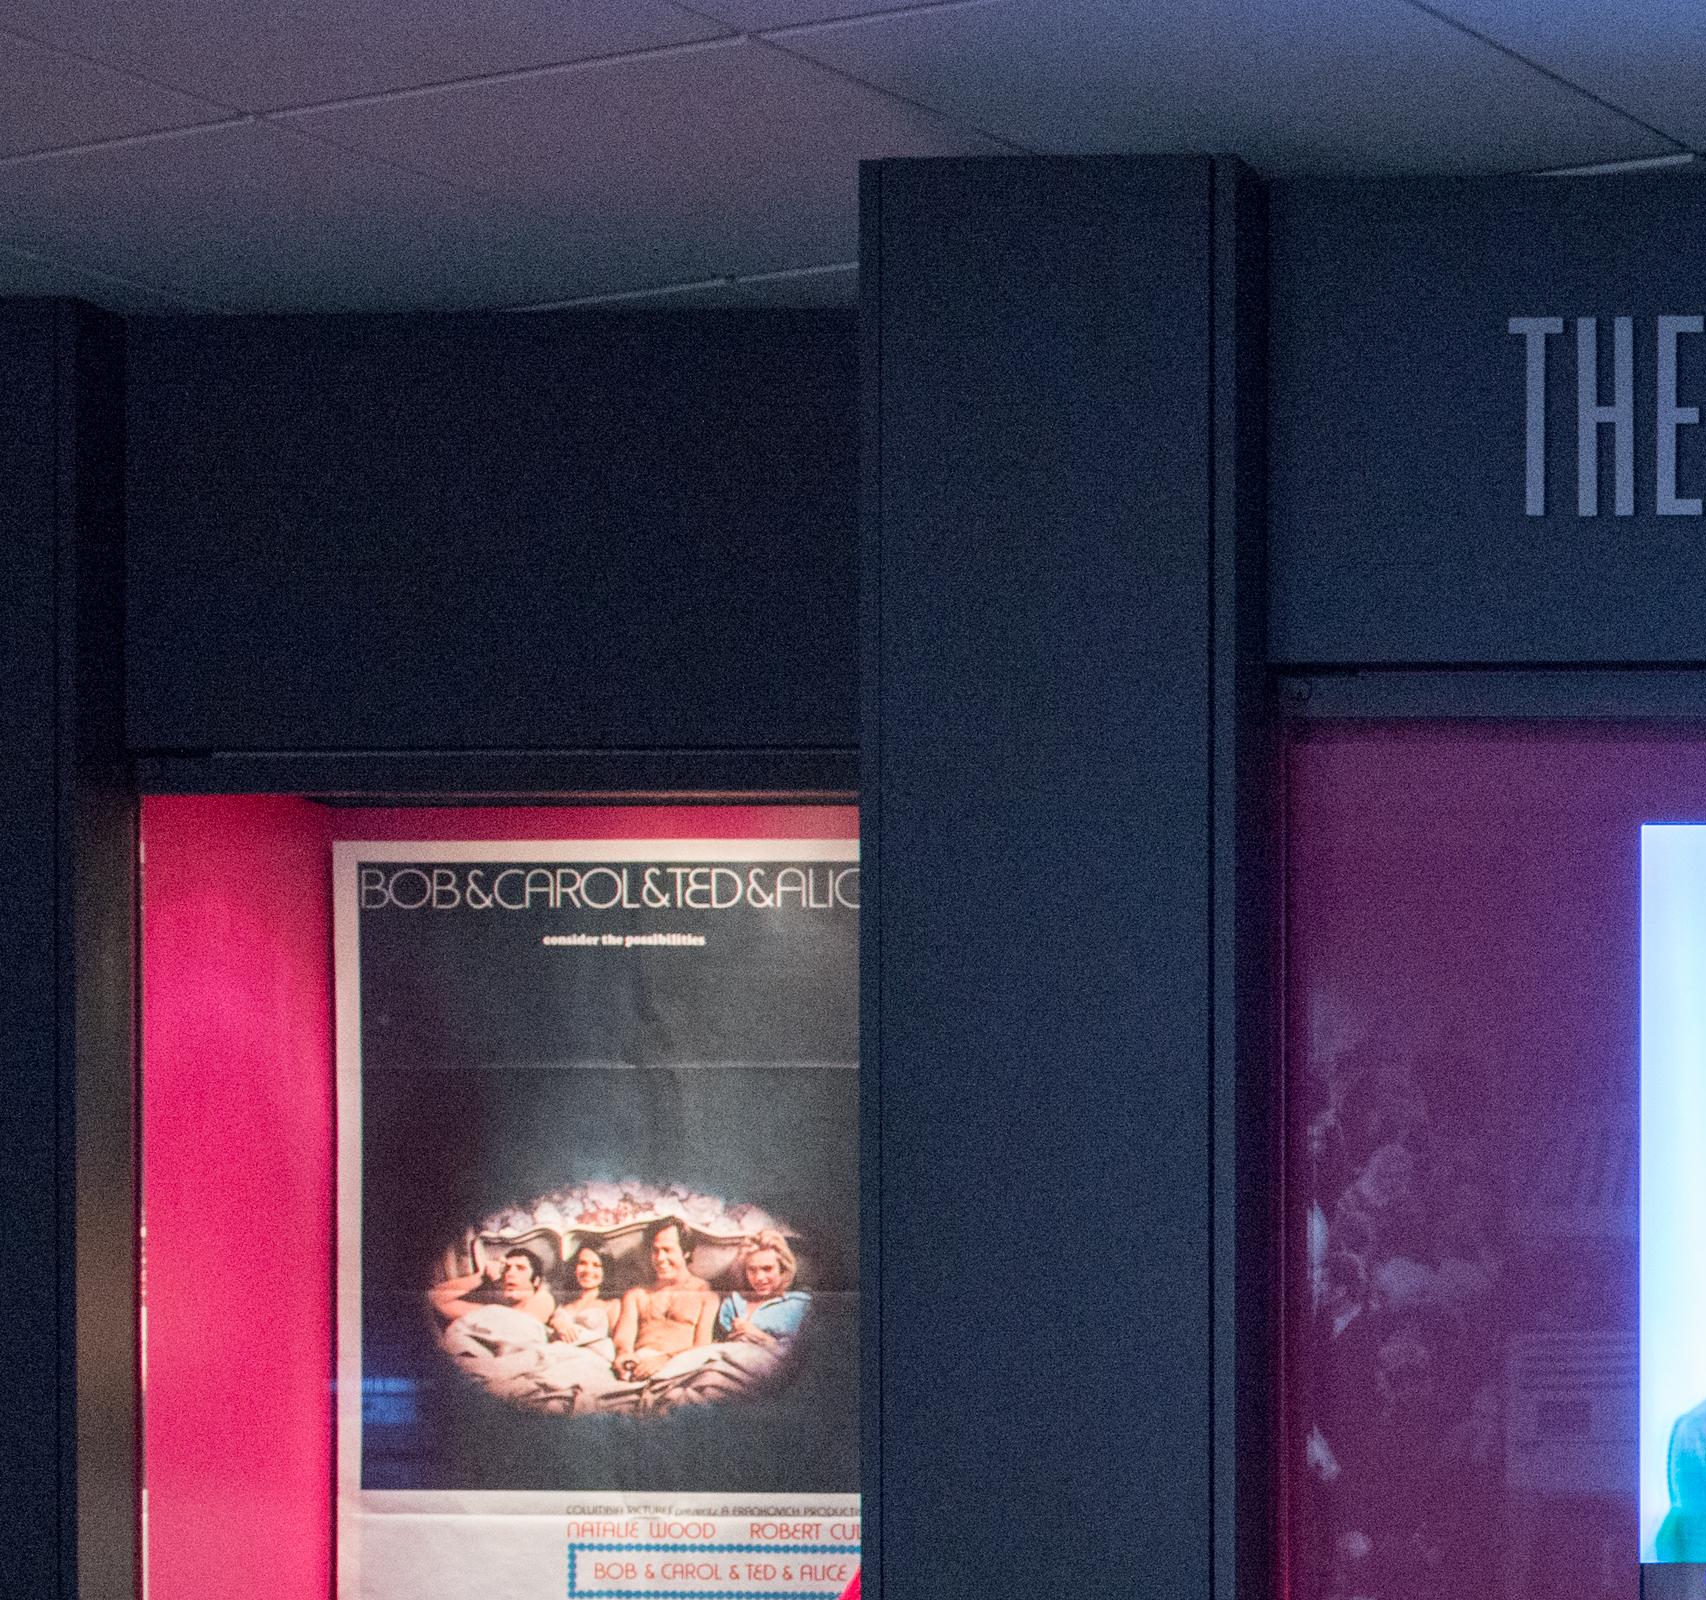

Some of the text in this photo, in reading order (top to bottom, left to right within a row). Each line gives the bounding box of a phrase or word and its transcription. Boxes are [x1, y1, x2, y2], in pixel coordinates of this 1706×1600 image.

[1508, 315, 1705, 516] THE
[543, 934, 705, 947] consider the possibilities
[594, 1563, 846, 1581] BOB & CAROL & TED & ALICE
